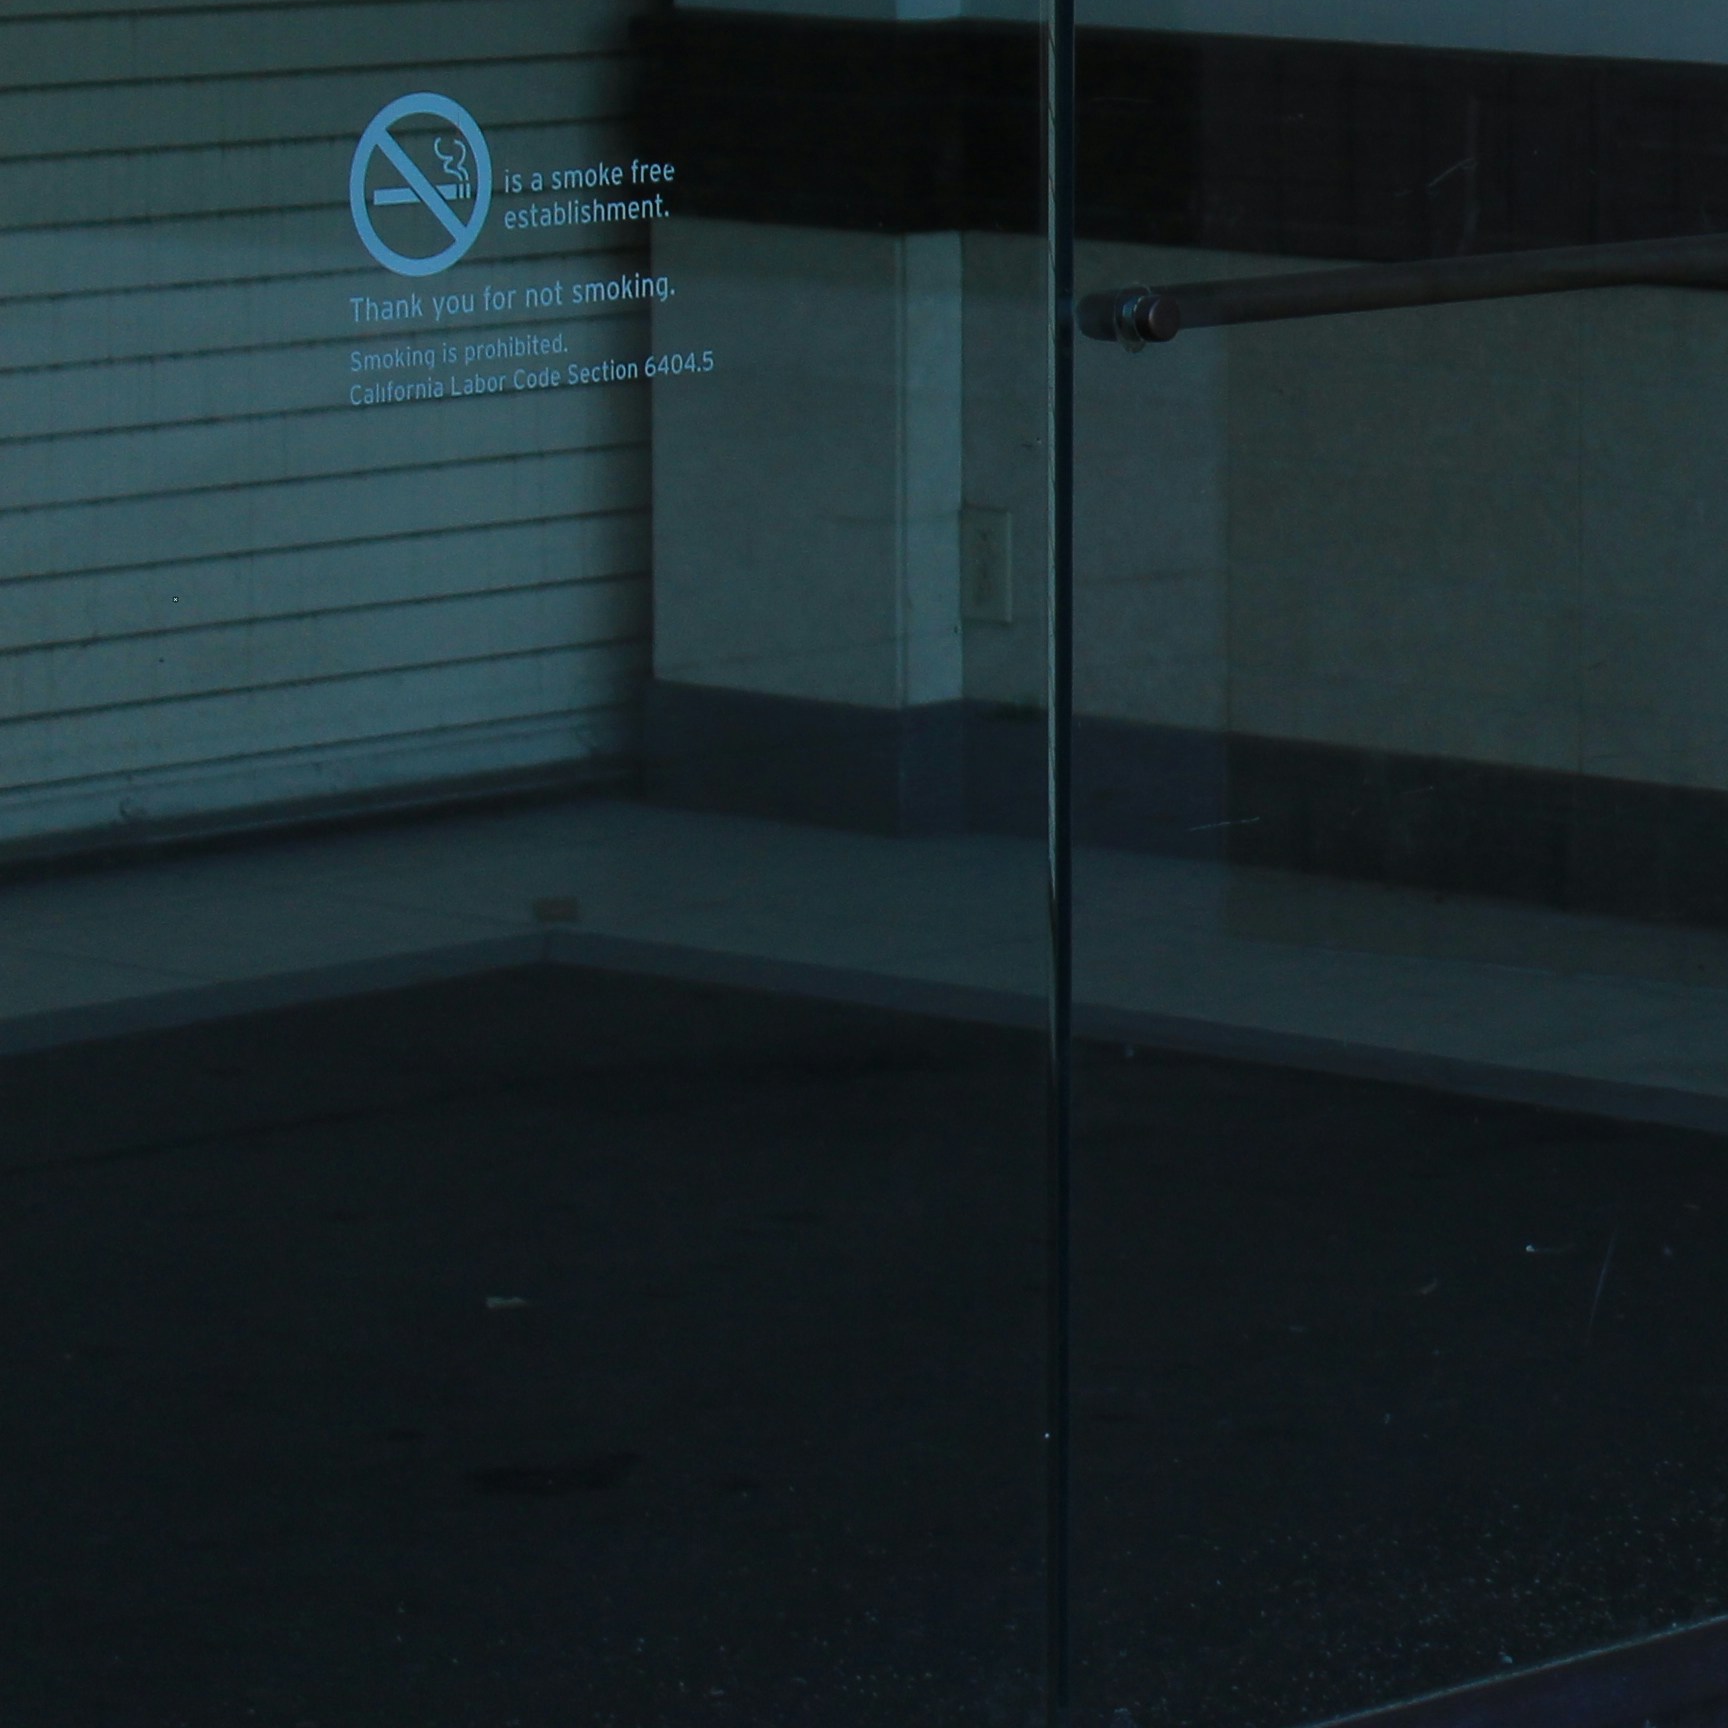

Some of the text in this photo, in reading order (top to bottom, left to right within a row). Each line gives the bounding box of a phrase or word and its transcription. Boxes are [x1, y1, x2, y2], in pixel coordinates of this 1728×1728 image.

[504, 158, 675, 194] is a smoke free
[503, 192, 670, 230] establishment.
[350, 272, 676, 323] Thank you for not smoking.
[350, 332, 569, 373] Smoking is prohibited.
[350, 350, 715, 406] California Labor Code Section 6404.5
